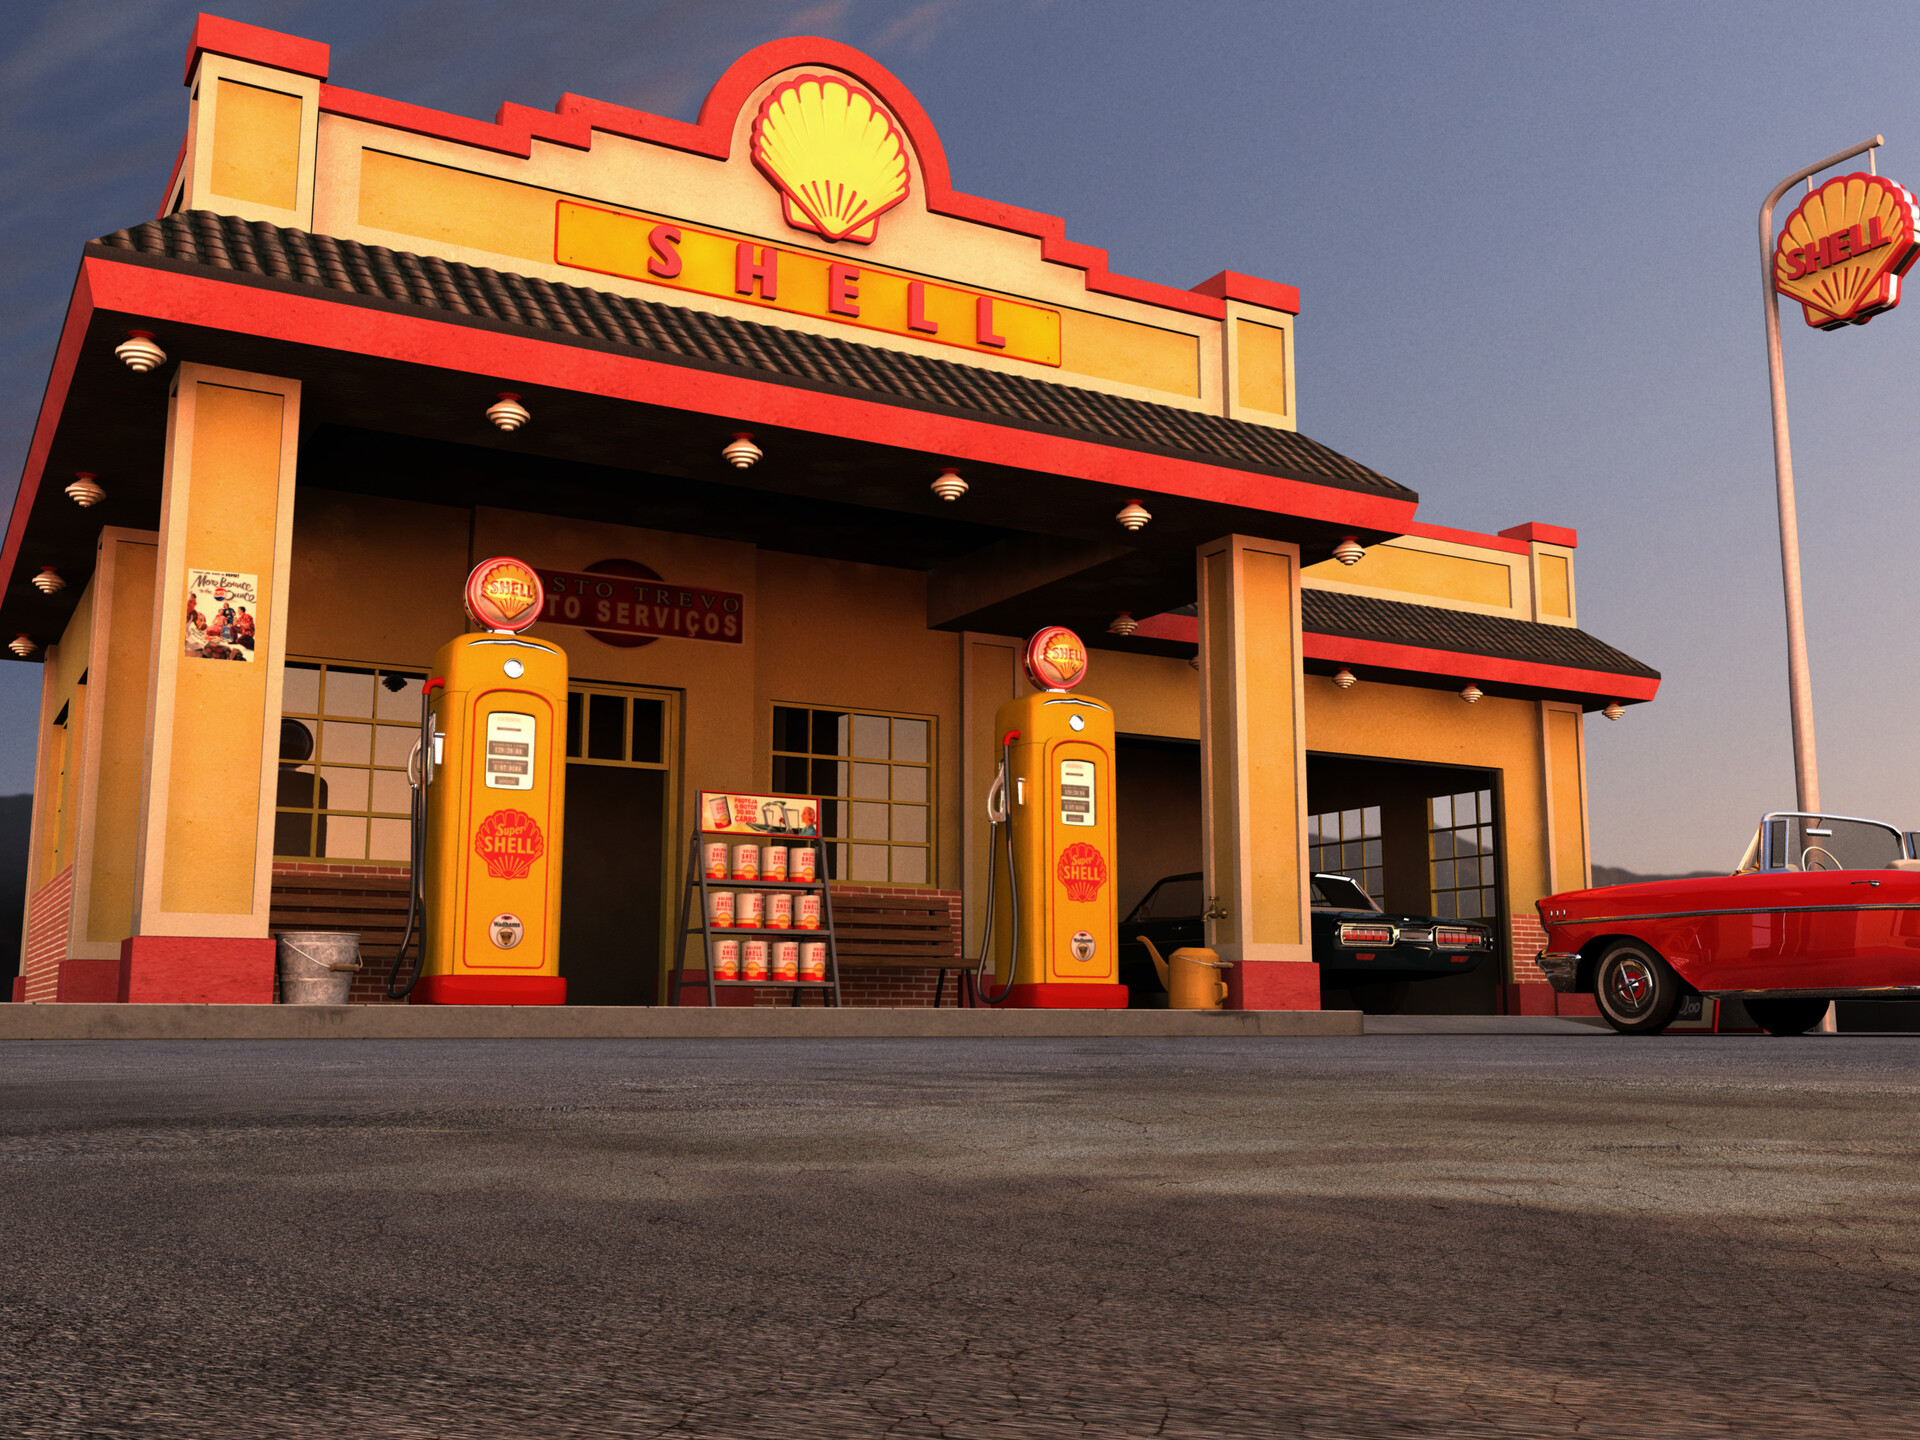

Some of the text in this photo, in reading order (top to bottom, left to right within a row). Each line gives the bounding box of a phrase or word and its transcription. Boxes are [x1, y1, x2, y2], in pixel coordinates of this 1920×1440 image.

[1785, 216, 1892, 280] SHELL
[647, 225, 1006, 349] SHELL
[191, 575, 254, 592] More Bounce
[490, 580, 533, 598] SHELL
[541, 575, 740, 613] STO TREVO
[545, 594, 737, 637] TO SERVIÇOS
[1052, 647, 1083, 662] SHELL
[735, 815, 757, 823] CARRO
[495, 823, 524, 837] Super
[484, 836, 535, 854] SHELL
[1064, 865, 1101, 881] SHELL
